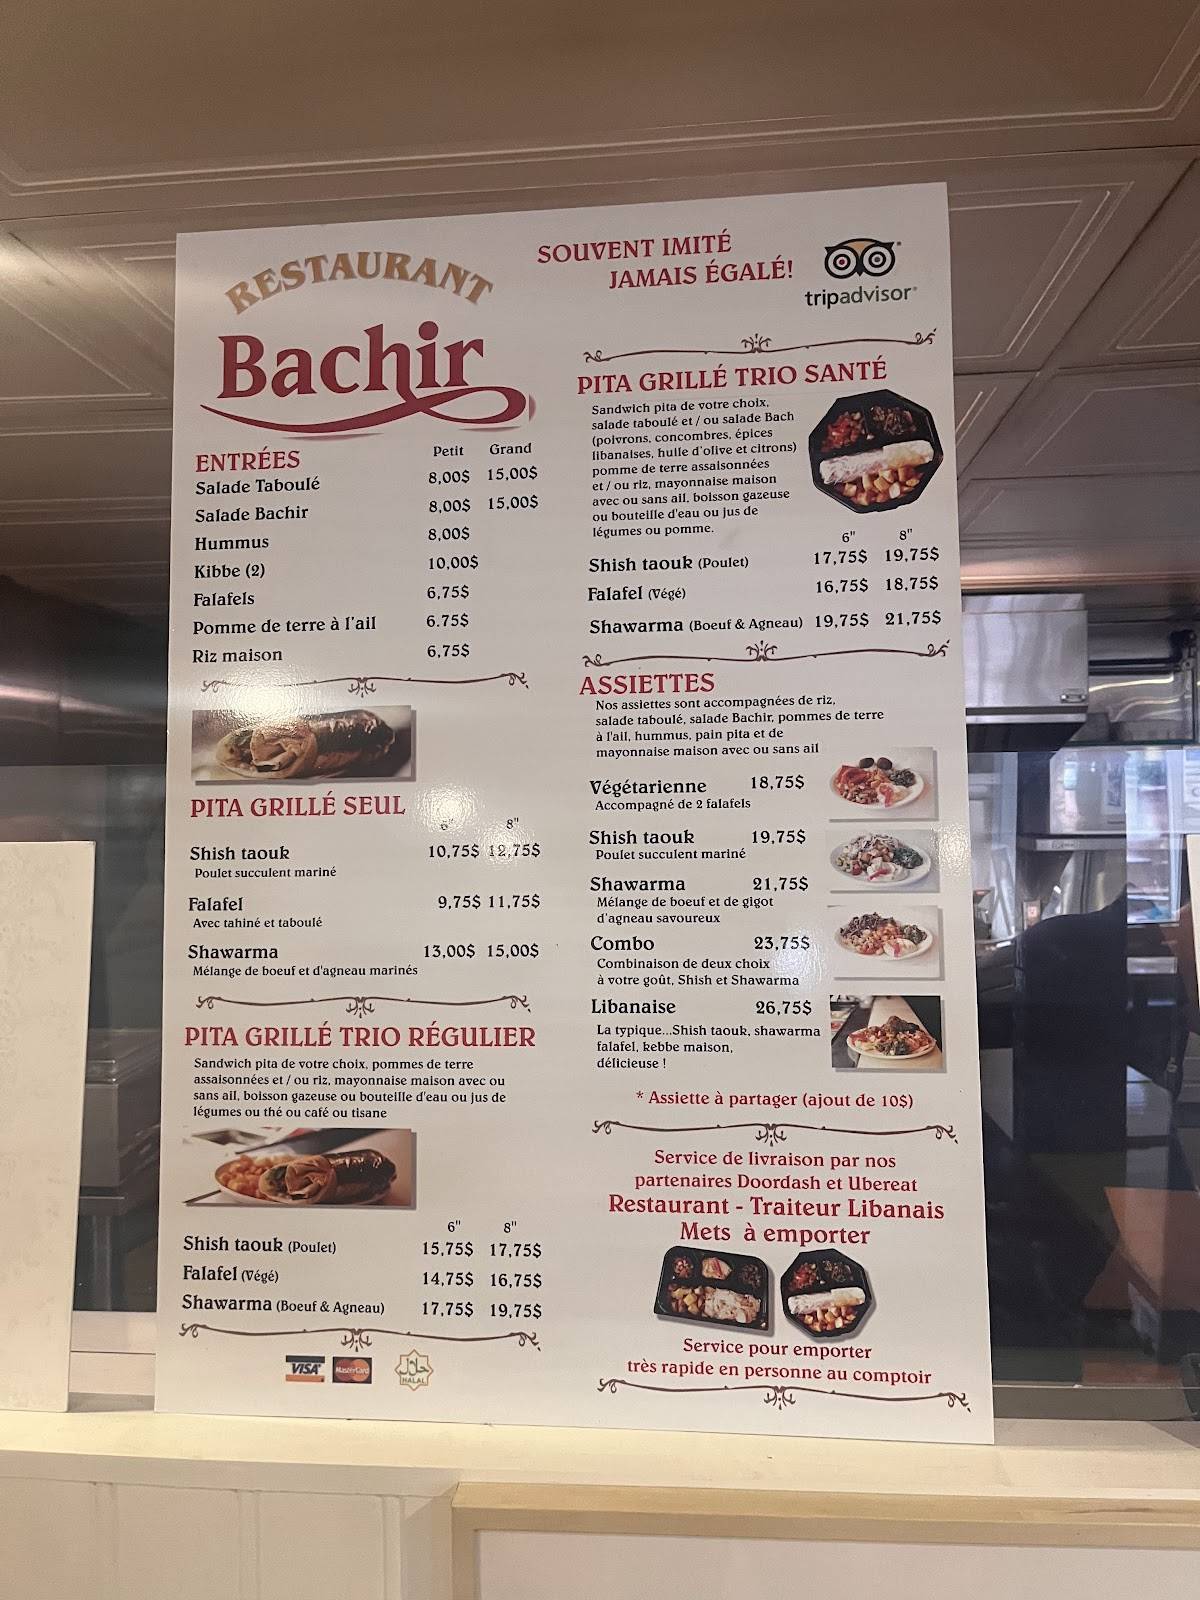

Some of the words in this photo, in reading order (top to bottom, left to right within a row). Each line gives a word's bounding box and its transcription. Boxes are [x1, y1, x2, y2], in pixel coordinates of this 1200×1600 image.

[537, 238, 655, 264] SOUVENT
[662, 228, 732, 256] IMITÉ
[609, 266, 697, 289] JAMAIS
[705, 254, 793, 284] ÉGALÉ!
[224, 251, 493, 315] RESTAURANT
[804, 285, 912, 310] tripadvisor
[217, 320, 484, 402] Bachir
[577, 374, 633, 395] PITA
[639, 363, 728, 392] GRILLÉ
[734, 365, 797, 387] TRIO
[804, 355, 887, 383] SANTÉ
[592, 434, 652, 448] (poivrons,
[655, 430, 732, 443] concombres,
[735, 428, 773, 441] épices
[433, 445, 464, 457] Petit
[489, 442, 532, 455] Grand
[195, 446, 300, 473] ENTRÉES
[592, 466, 638, 478] pomme
[641, 463, 656, 474] de
[659, 464, 689, 473] terre
[691, 458, 770, 472] assaisonnées
[428, 469, 470, 485] 8,00$
[488, 465, 538, 481] 15,00$
[195, 480, 251, 496] Salade
[255, 475, 320, 493] Taboulé
[429, 498, 471, 514] 8,00$
[488, 494, 539, 511] 15,00$
[194, 507, 250, 523] Salade
[254, 505, 309, 521] Bachir
[428, 526, 470, 542] 8,00$
[593, 526, 642, 539] légumes
[645, 527, 661, 535] ou
[664, 525, 714, 537] pomme.
[194, 537, 269, 551] Hummus
[429, 554, 479, 571] 10,00$
[814, 549, 868, 566] 17,75$
[885, 546, 939, 563] 19,75$
[194, 560, 241, 579] Kibbe
[245, 563, 265, 579] (2)
[588, 557, 637, 573] Shish
[642, 555, 693, 571] taouk
[698, 556, 749, 570] (Poulet)
[427, 584, 469, 600] 6,75$
[816, 577, 869, 594] 16,75$
[886, 575, 939, 592] 18,75$
[193, 591, 255, 607] Falafels
[587, 585, 643, 602] Falafel
[648, 585, 686, 602] (Végé)
[193, 621, 257, 635] Pomme
[261, 618, 281, 633] de
[285, 620, 326, 632] terre
[330, 616, 340, 631] à
[345, 616, 376, 630] l'ail
[589, 619, 684, 634] Shawarma
[689, 619, 732, 633] (Boeuf
[734, 618, 746, 630] &
[748, 616, 803, 631] Agneau)
[815, 612, 869, 629] 19,75$
[885, 609, 941, 626] 21,75$
[192, 649, 217, 664] Riz
[222, 648, 283, 663] maison
[427, 643, 470, 659] 6,75$
[579, 672, 715, 695] ASSIETTES
[589, 778, 707, 798] Végétarienne
[751, 774, 805, 790] 18,75$
[190, 798, 244, 818] PITA
[250, 790, 336, 817] GRILLÉ
[343, 795, 406, 816] SEUL
[595, 798, 675, 813] Accompagné
[677, 798, 693, 809] de
[696, 799, 703, 809] 2
[706, 798, 751, 809] falafels
[589, 829, 638, 845] Shish
[642, 829, 695, 845] taouk
[752, 829, 806, 845] 19,75$
[189, 846, 236, 861] Shish
[241, 845, 290, 860] taouk
[428, 843, 480, 858] 10,75$
[195, 868, 232, 878] Poulet
[234, 867, 291, 878] succulent
[294, 866, 337, 877] mariné
[590, 876, 686, 892] Shawarma
[753, 876, 809, 892] 21,75$
[188, 896, 244, 912] Falafel
[438, 894, 481, 910] 9,75$
[489, 893, 540, 909] 11,75$
[597, 912, 653, 926] d'agneau
[656, 915, 721, 923] savoureux
[187, 944, 279, 959] Shawarma
[424, 943, 476, 959] 13,00$
[488, 942, 539, 959] 15,00$
[590, 935, 655, 951] Combo
[754, 935, 810, 952] 23,75$
[591, 998, 676, 1014] Libanaise
[755, 999, 812, 1016] 26,75$
[184, 1026, 239, 1047] PITA
[245, 1020, 332, 1047] GRILLÉ
[339, 1026, 401, 1047] TRIO
[408, 1020, 536, 1047] RÉGULIER
[596, 1040, 639, 1053] falafel,
[642, 1041, 680, 1052] kebbe
[683, 1042, 733, 1053] maison,
[597, 1057, 659, 1069] délicieuse
[663, 1057, 666, 1069] !
[654, 1149, 718, 1165] Service
[722, 1151, 744, 1165] de
[748, 1151, 825, 1167] livraison
[830, 1156, 860, 1171] par
[865, 1157, 896, 1168] nos
[634, 1173, 732, 1190] partenaires
[737, 1174, 821, 1190] Doordash
[826, 1177, 844, 1190] et
[848, 1176, 918, 1192] Ubereat
[609, 1194, 730, 1215] Restaurant
[749, 1196, 841, 1217] Traiteur
[847, 1198, 944, 1219] Libanais
[680, 1221, 731, 1241] Mets
[743, 1222, 757, 1242] à
[763, 1227, 871, 1247] emporter
[183, 1235, 229, 1252] Shish
[234, 1236, 283, 1252] taouk
[288, 1241, 336, 1255] (Poulet)
[423, 1241, 474, 1258] 15,75$
[490, 1242, 542, 1259] 17,75$
[182, 1265, 238, 1281] Falafel
[241, 1269, 279, 1284] (Végé)
[423, 1271, 474, 1288] 14,75$
[490, 1272, 542, 1289] 16,75$
[181, 1294, 272, 1311] Shawarma
[276, 1299, 317, 1313] (Boeuf
[319, 1300, 330, 1313] &
[332, 1301, 385, 1316] Agneau)
[422, 1301, 474, 1318] 17,75$
[490, 1303, 542, 1320] 19,75$
[683, 1338, 744, 1354] Service
[748, 1344, 789, 1358] pour
[793, 1345, 872, 1361] emporter
[292, 1363, 319, 1374] VISA
